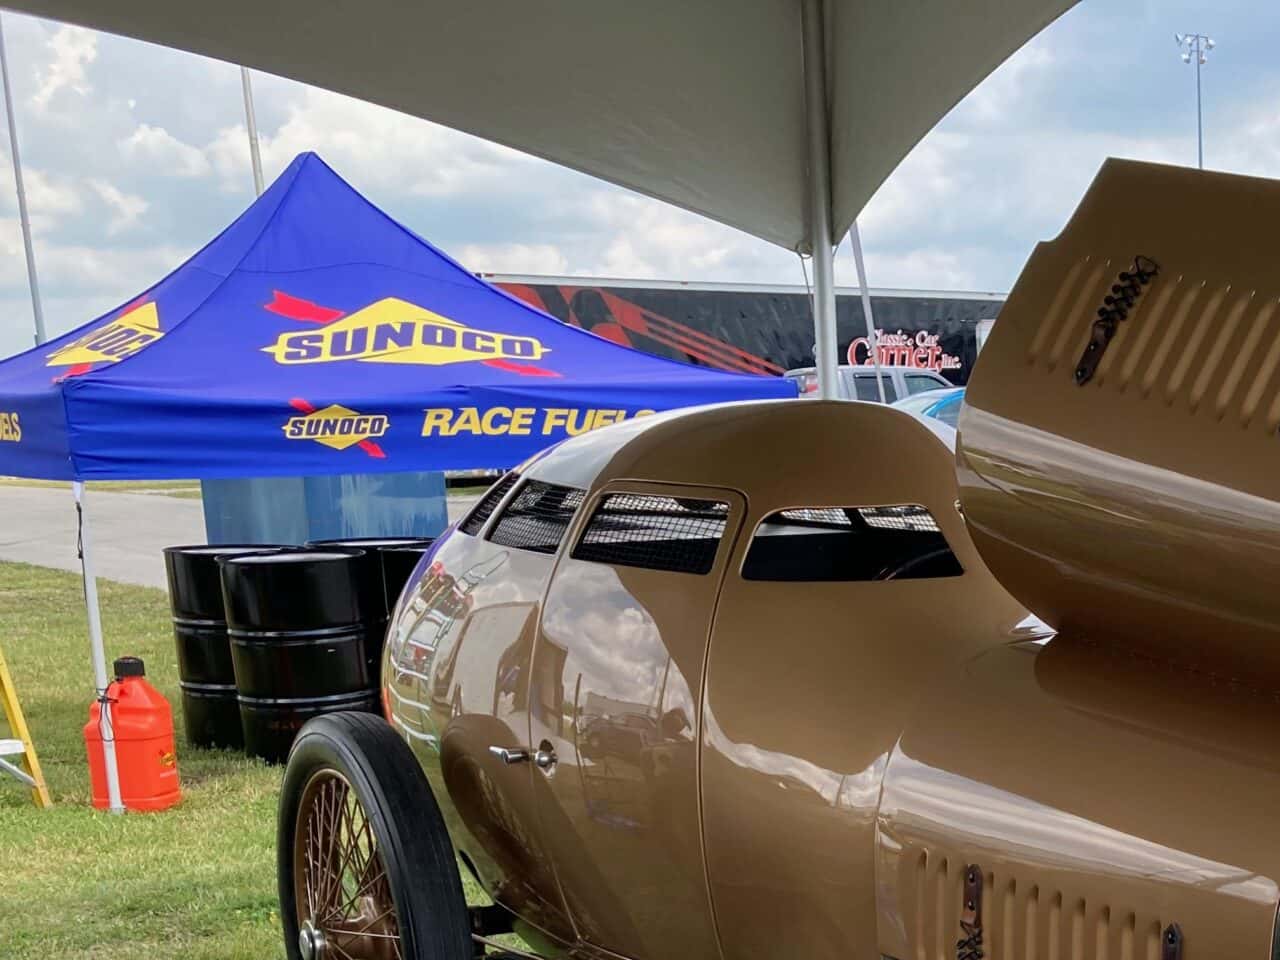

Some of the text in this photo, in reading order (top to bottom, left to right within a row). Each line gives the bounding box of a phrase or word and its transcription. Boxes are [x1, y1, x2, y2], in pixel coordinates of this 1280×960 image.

[284, 320, 541, 361] SUNOCO
[916, 331, 939, 346] Car
[288, 415, 385, 439] SUNOCO
[421, 407, 658, 437] RACE FUE
